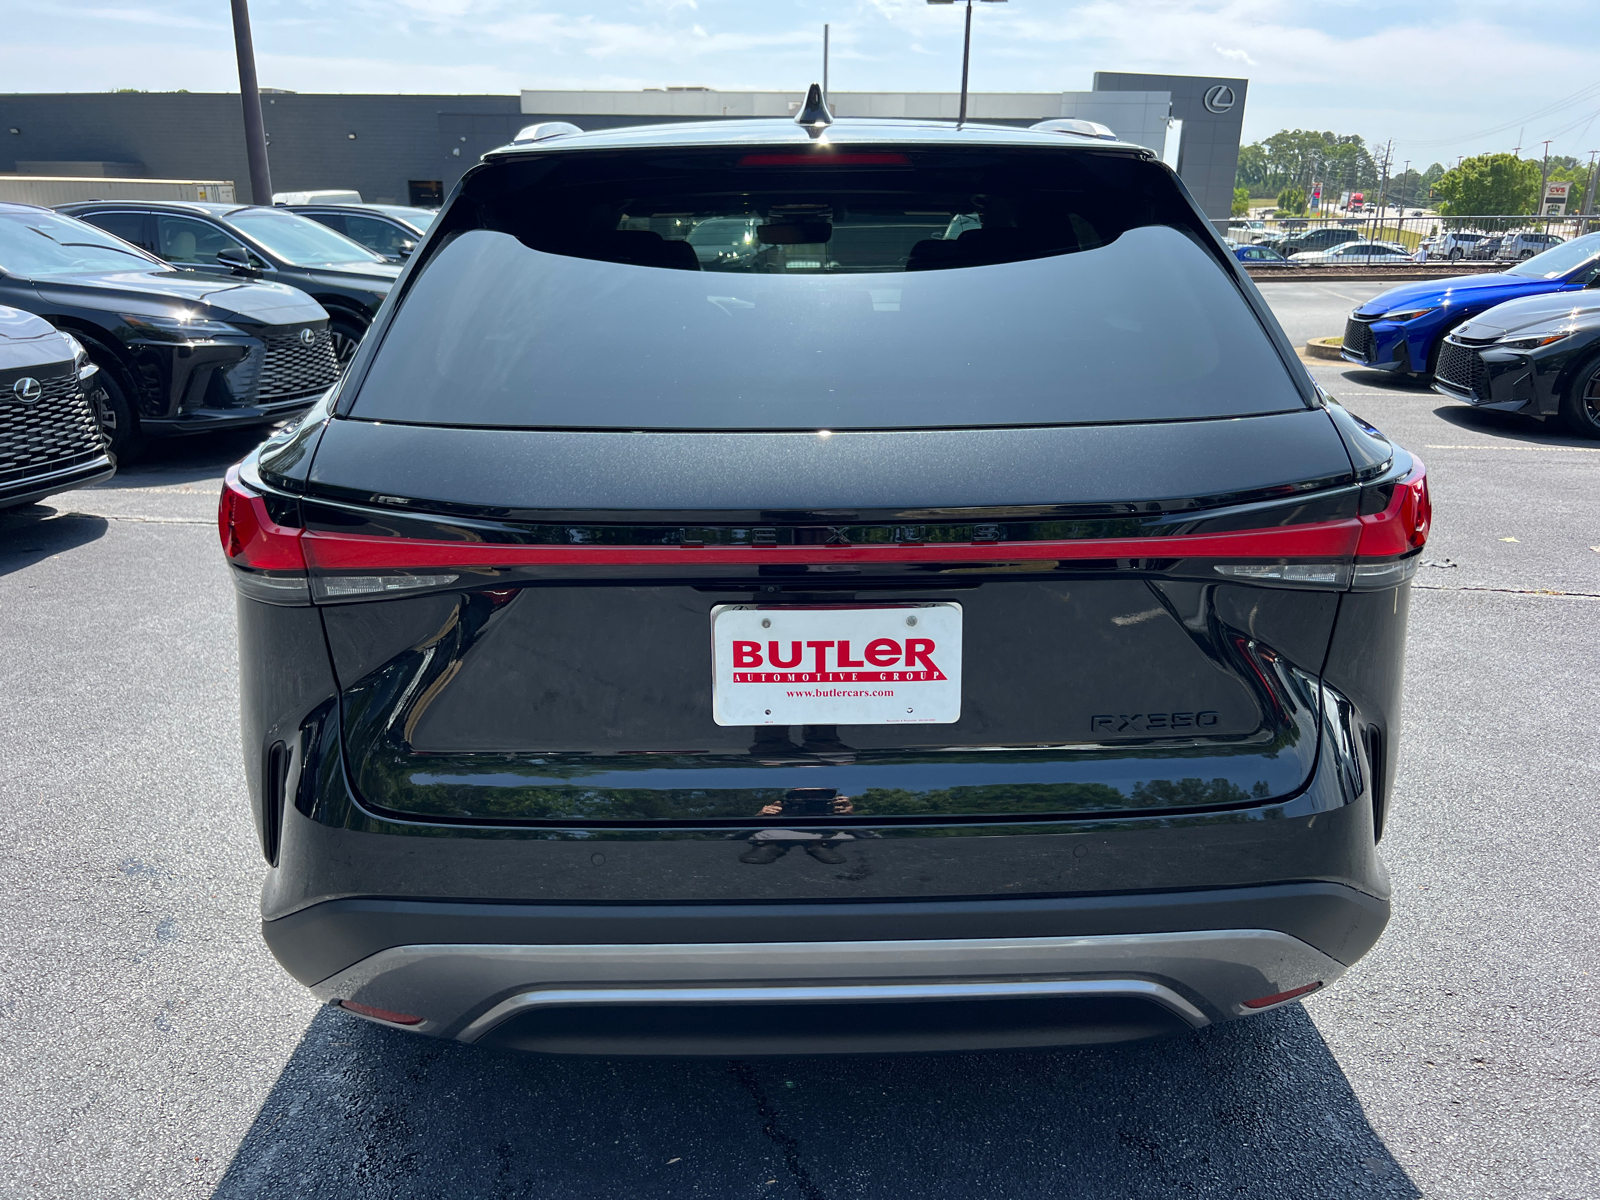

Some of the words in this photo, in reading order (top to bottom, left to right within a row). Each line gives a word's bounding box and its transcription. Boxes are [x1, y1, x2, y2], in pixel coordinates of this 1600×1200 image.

[679, 524, 1000, 545] LEXUS
[734, 672, 858, 682] AUTOMOTIVE
[879, 671, 940, 681] GROUP
[786, 688, 894, 697] www.butlercars.com
